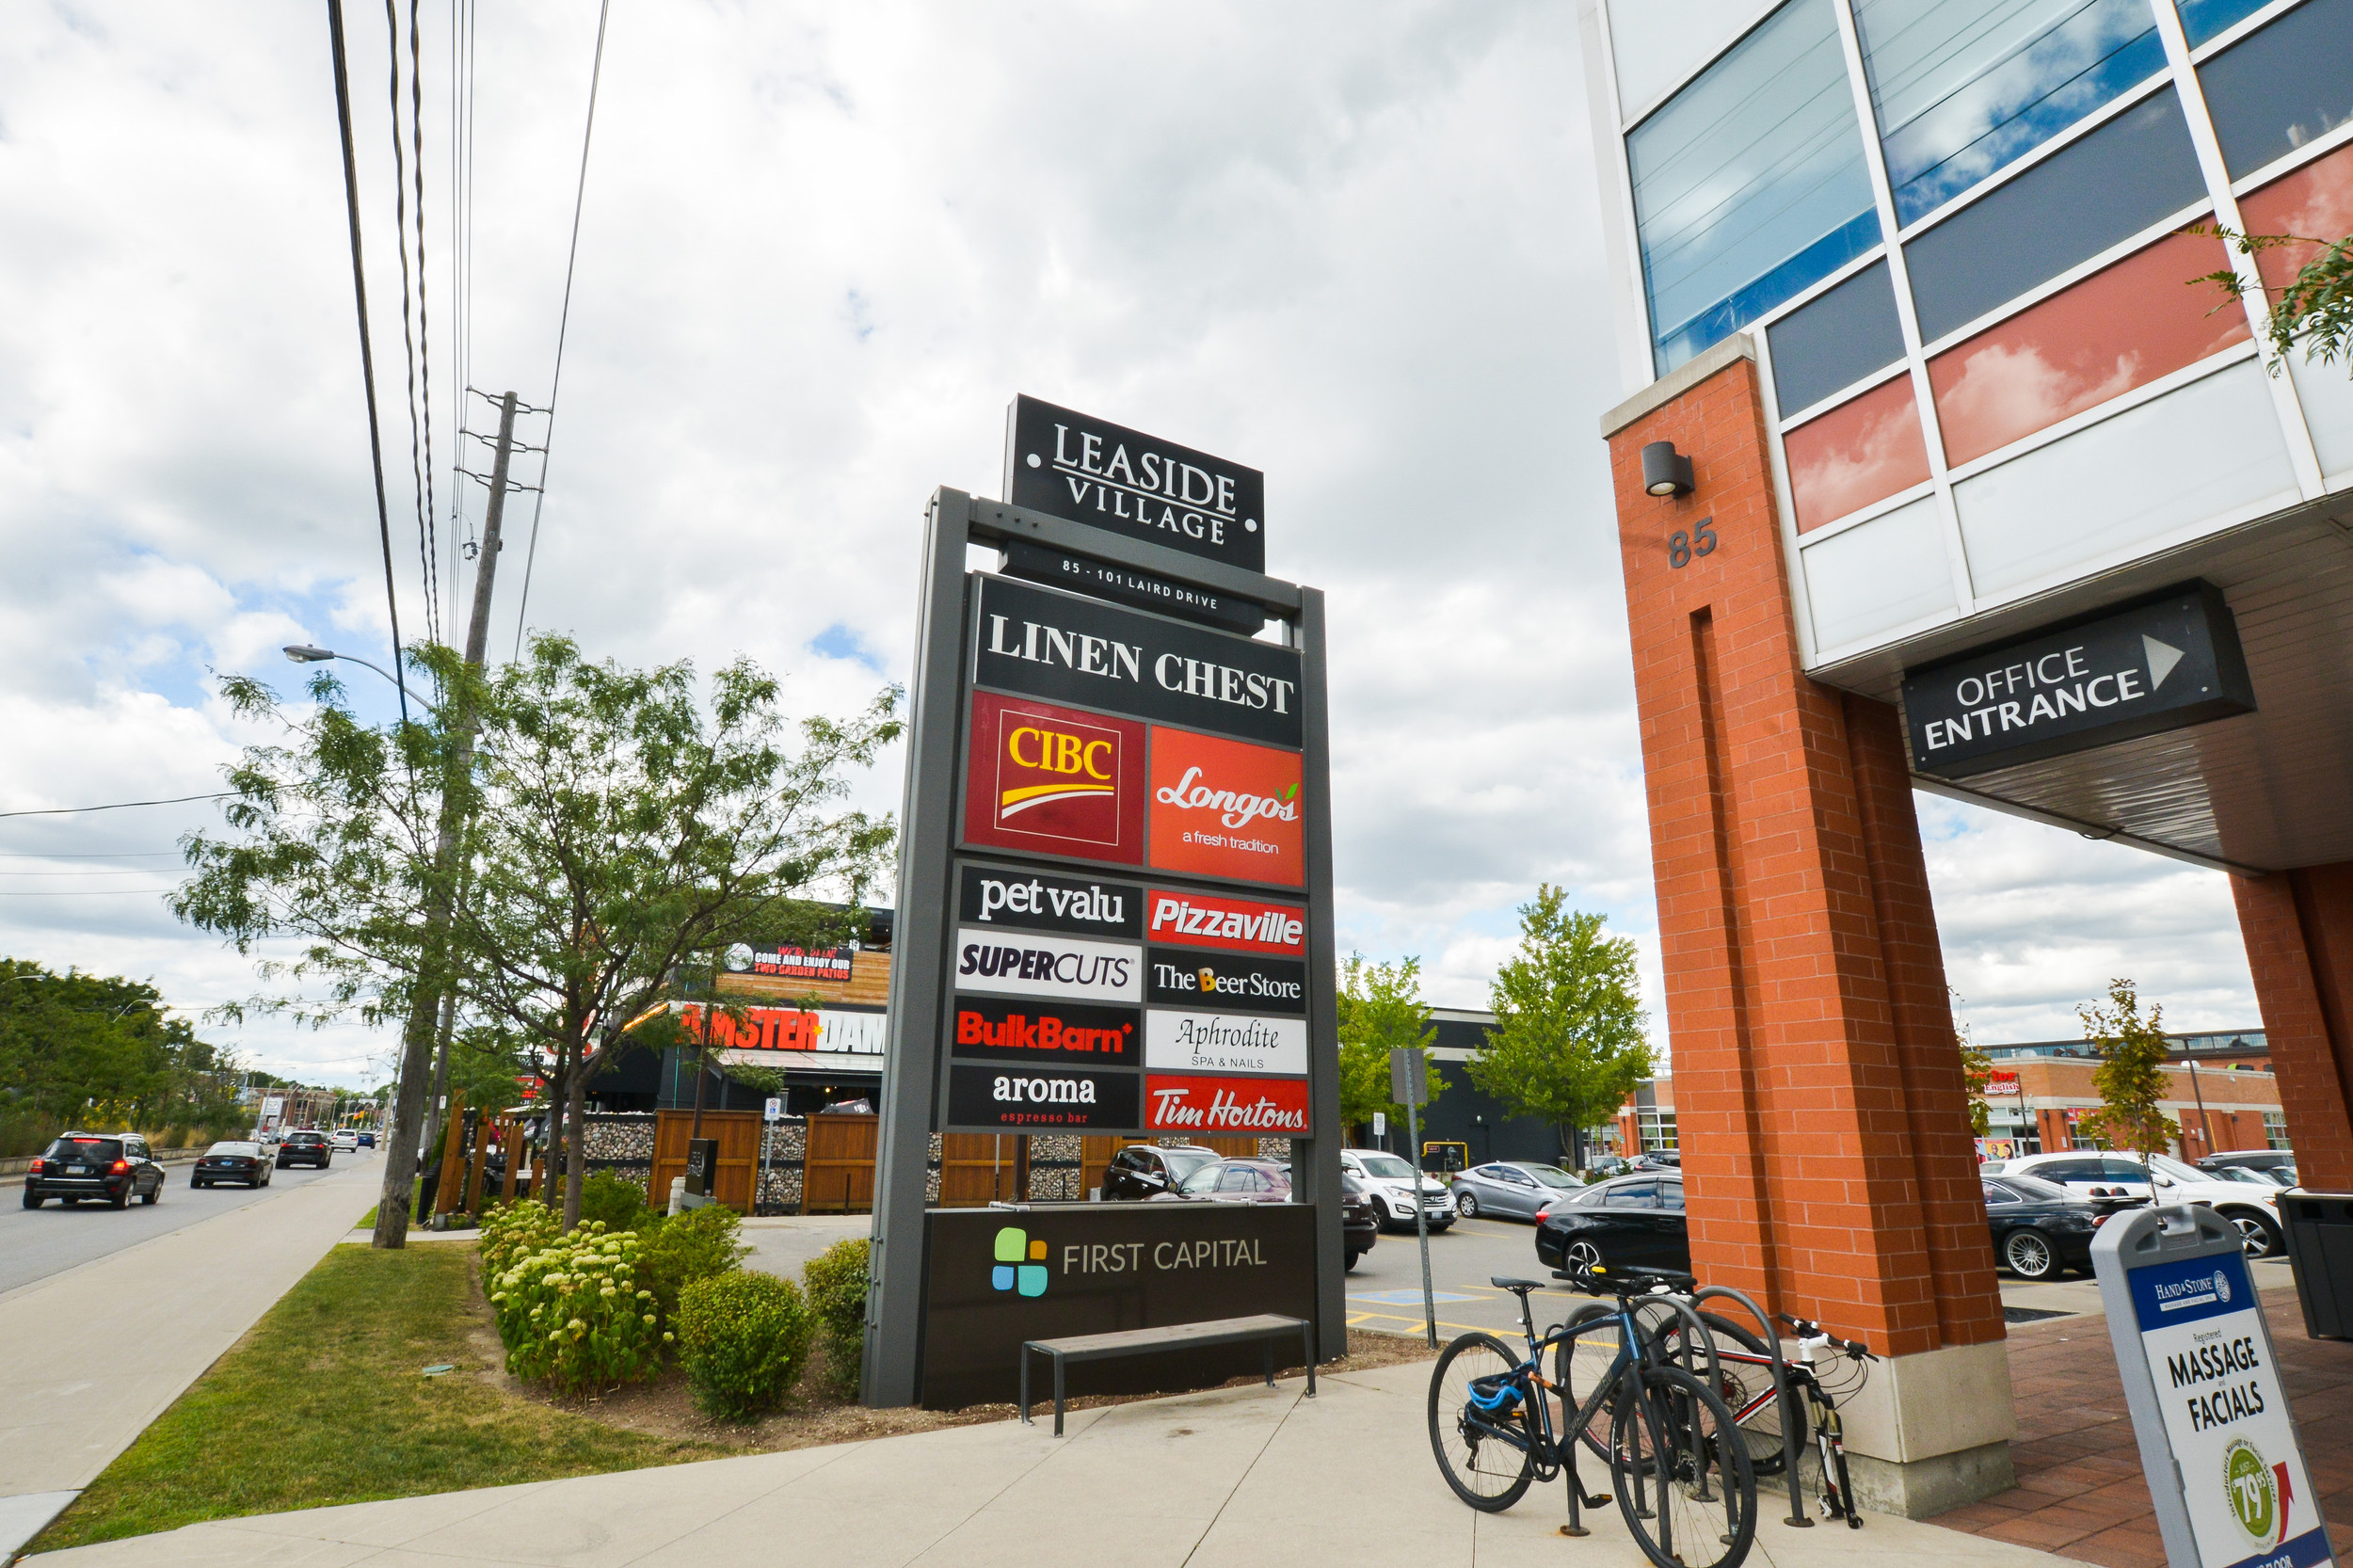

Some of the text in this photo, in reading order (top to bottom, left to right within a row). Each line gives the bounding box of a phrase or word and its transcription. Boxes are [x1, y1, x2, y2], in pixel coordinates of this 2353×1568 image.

[1053, 424, 1236, 515] LEASIDE
[1065, 476, 1225, 545] VILLAGE
[1669, 516, 1717, 568] 85
[1063, 560, 1080, 574] 85
[1097, 569, 1122, 585] 101
[1128, 577, 1171, 598] LAIRD
[1176, 591, 1218, 610] DRIVE
[988, 615, 1294, 714] LINEN CHEST
[1956, 646, 2090, 708] OFFICE
[1925, 668, 2145, 751] ENTRANCE
[1009, 727, 1112, 780] CIBC
[1182, 830, 1279, 855] a fresh tradition
[979, 878, 1125, 923] pet valu
[1151, 899, 1304, 945] Pizzaville
[755, 952, 781, 964] COME
[782, 955, 802, 966] AND
[803, 956, 830, 968] ENJOY
[831, 959, 850, 969] OUR
[755, 963, 849, 979] TWO GARDEN PATIOS
[1155, 964, 1301, 999] The Beer Store
[1176, 1018, 1279, 1054] Aphrodite
[1192, 1057, 1264, 1069] SPA & NAILS
[993, 1076, 1096, 1104] aroma
[1152, 1088, 1303, 1128] Tim Hortons
[1985, 1083, 2020, 1092] English
[1001, 1112, 1088, 1124] espresso bar
[1064, 1239, 1267, 1274] FIRST CAPITAL
[2193, 1326, 2221, 1344] Registered
[2168, 1336, 2259, 1388] MASSAGE
[2187, 1381, 2264, 1432] FACIALS
